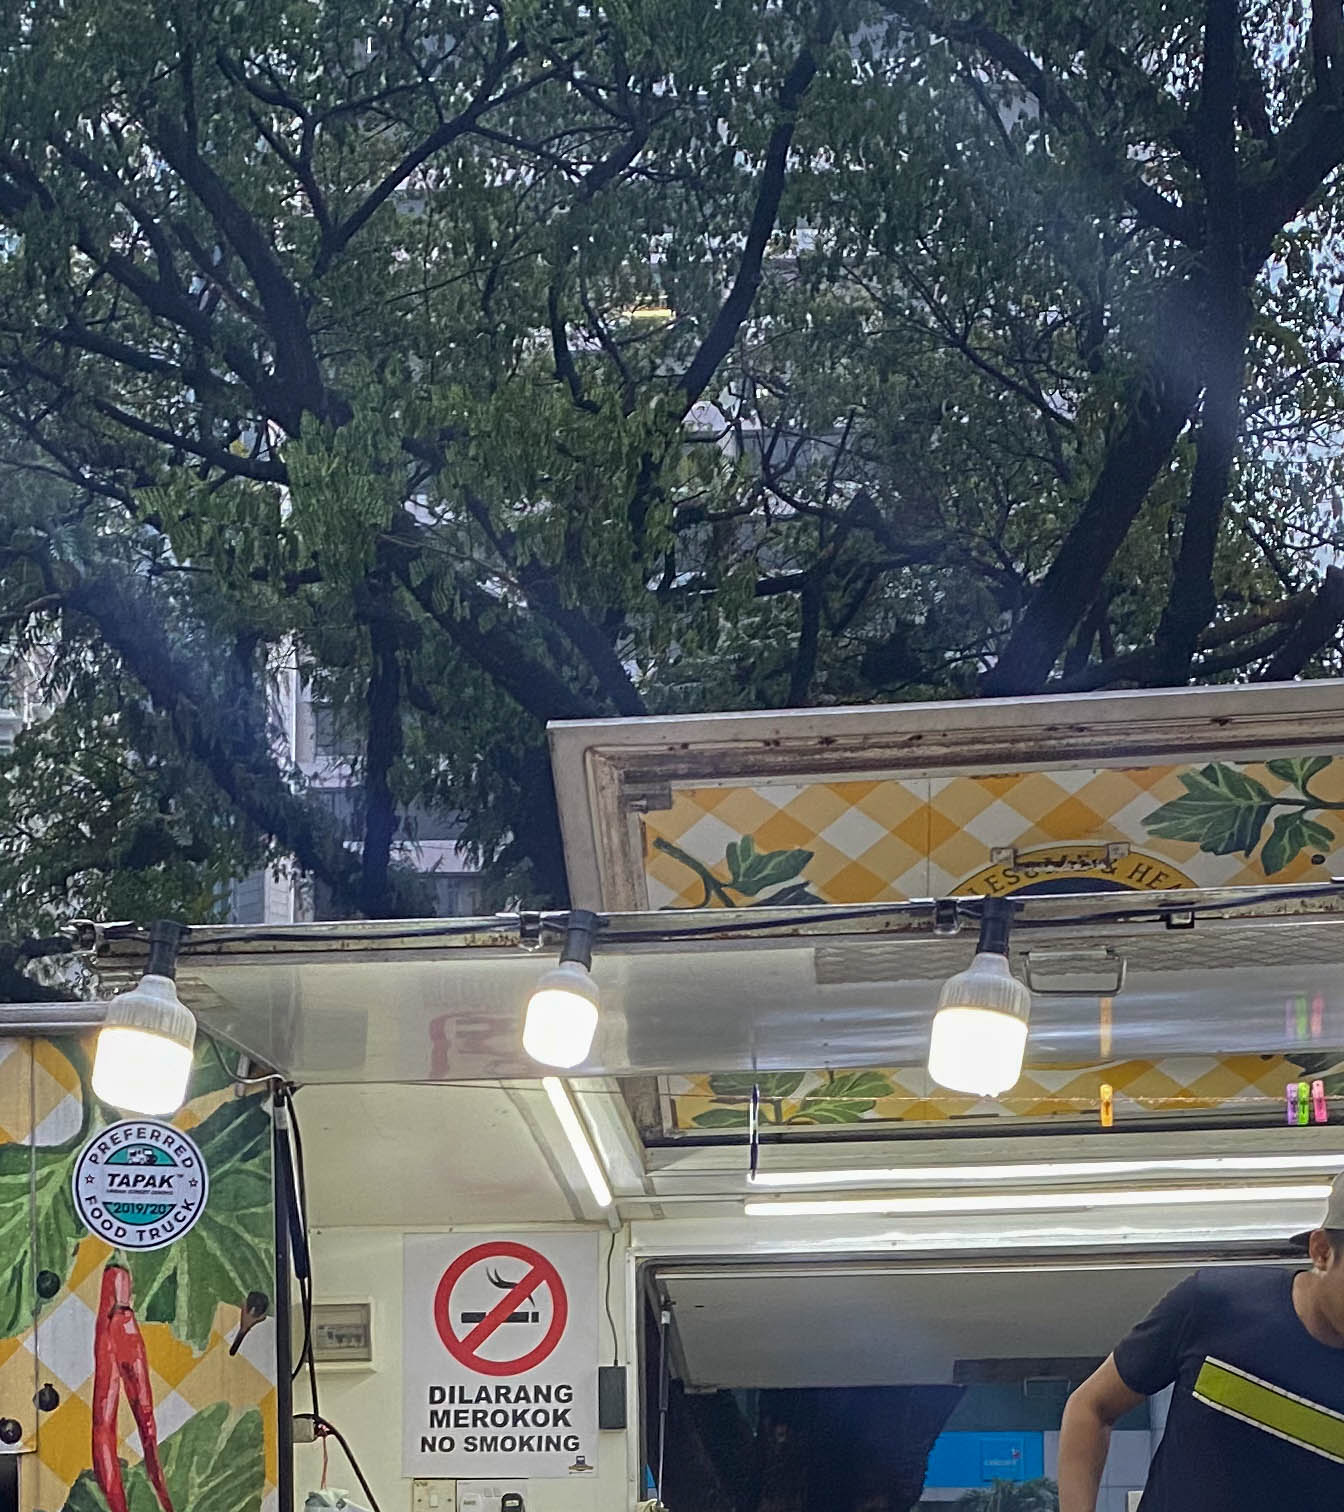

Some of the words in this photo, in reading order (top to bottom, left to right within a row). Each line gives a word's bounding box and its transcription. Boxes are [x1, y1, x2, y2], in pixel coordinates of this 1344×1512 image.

[88, 1127, 194, 1169] PREFERRED
[107, 1173, 175, 1188] TAPAK
[84, 1195, 127, 1238] FOOD
[136, 1198, 196, 1242] TRUCK
[113, 1203, 167, 1214] 2019/20
[428, 1384, 573, 1405] DILARANG
[429, 1408, 572, 1428] MEROKOK
[420, 1435, 455, 1453] NO
[463, 1434, 580, 1452] SMOKING
